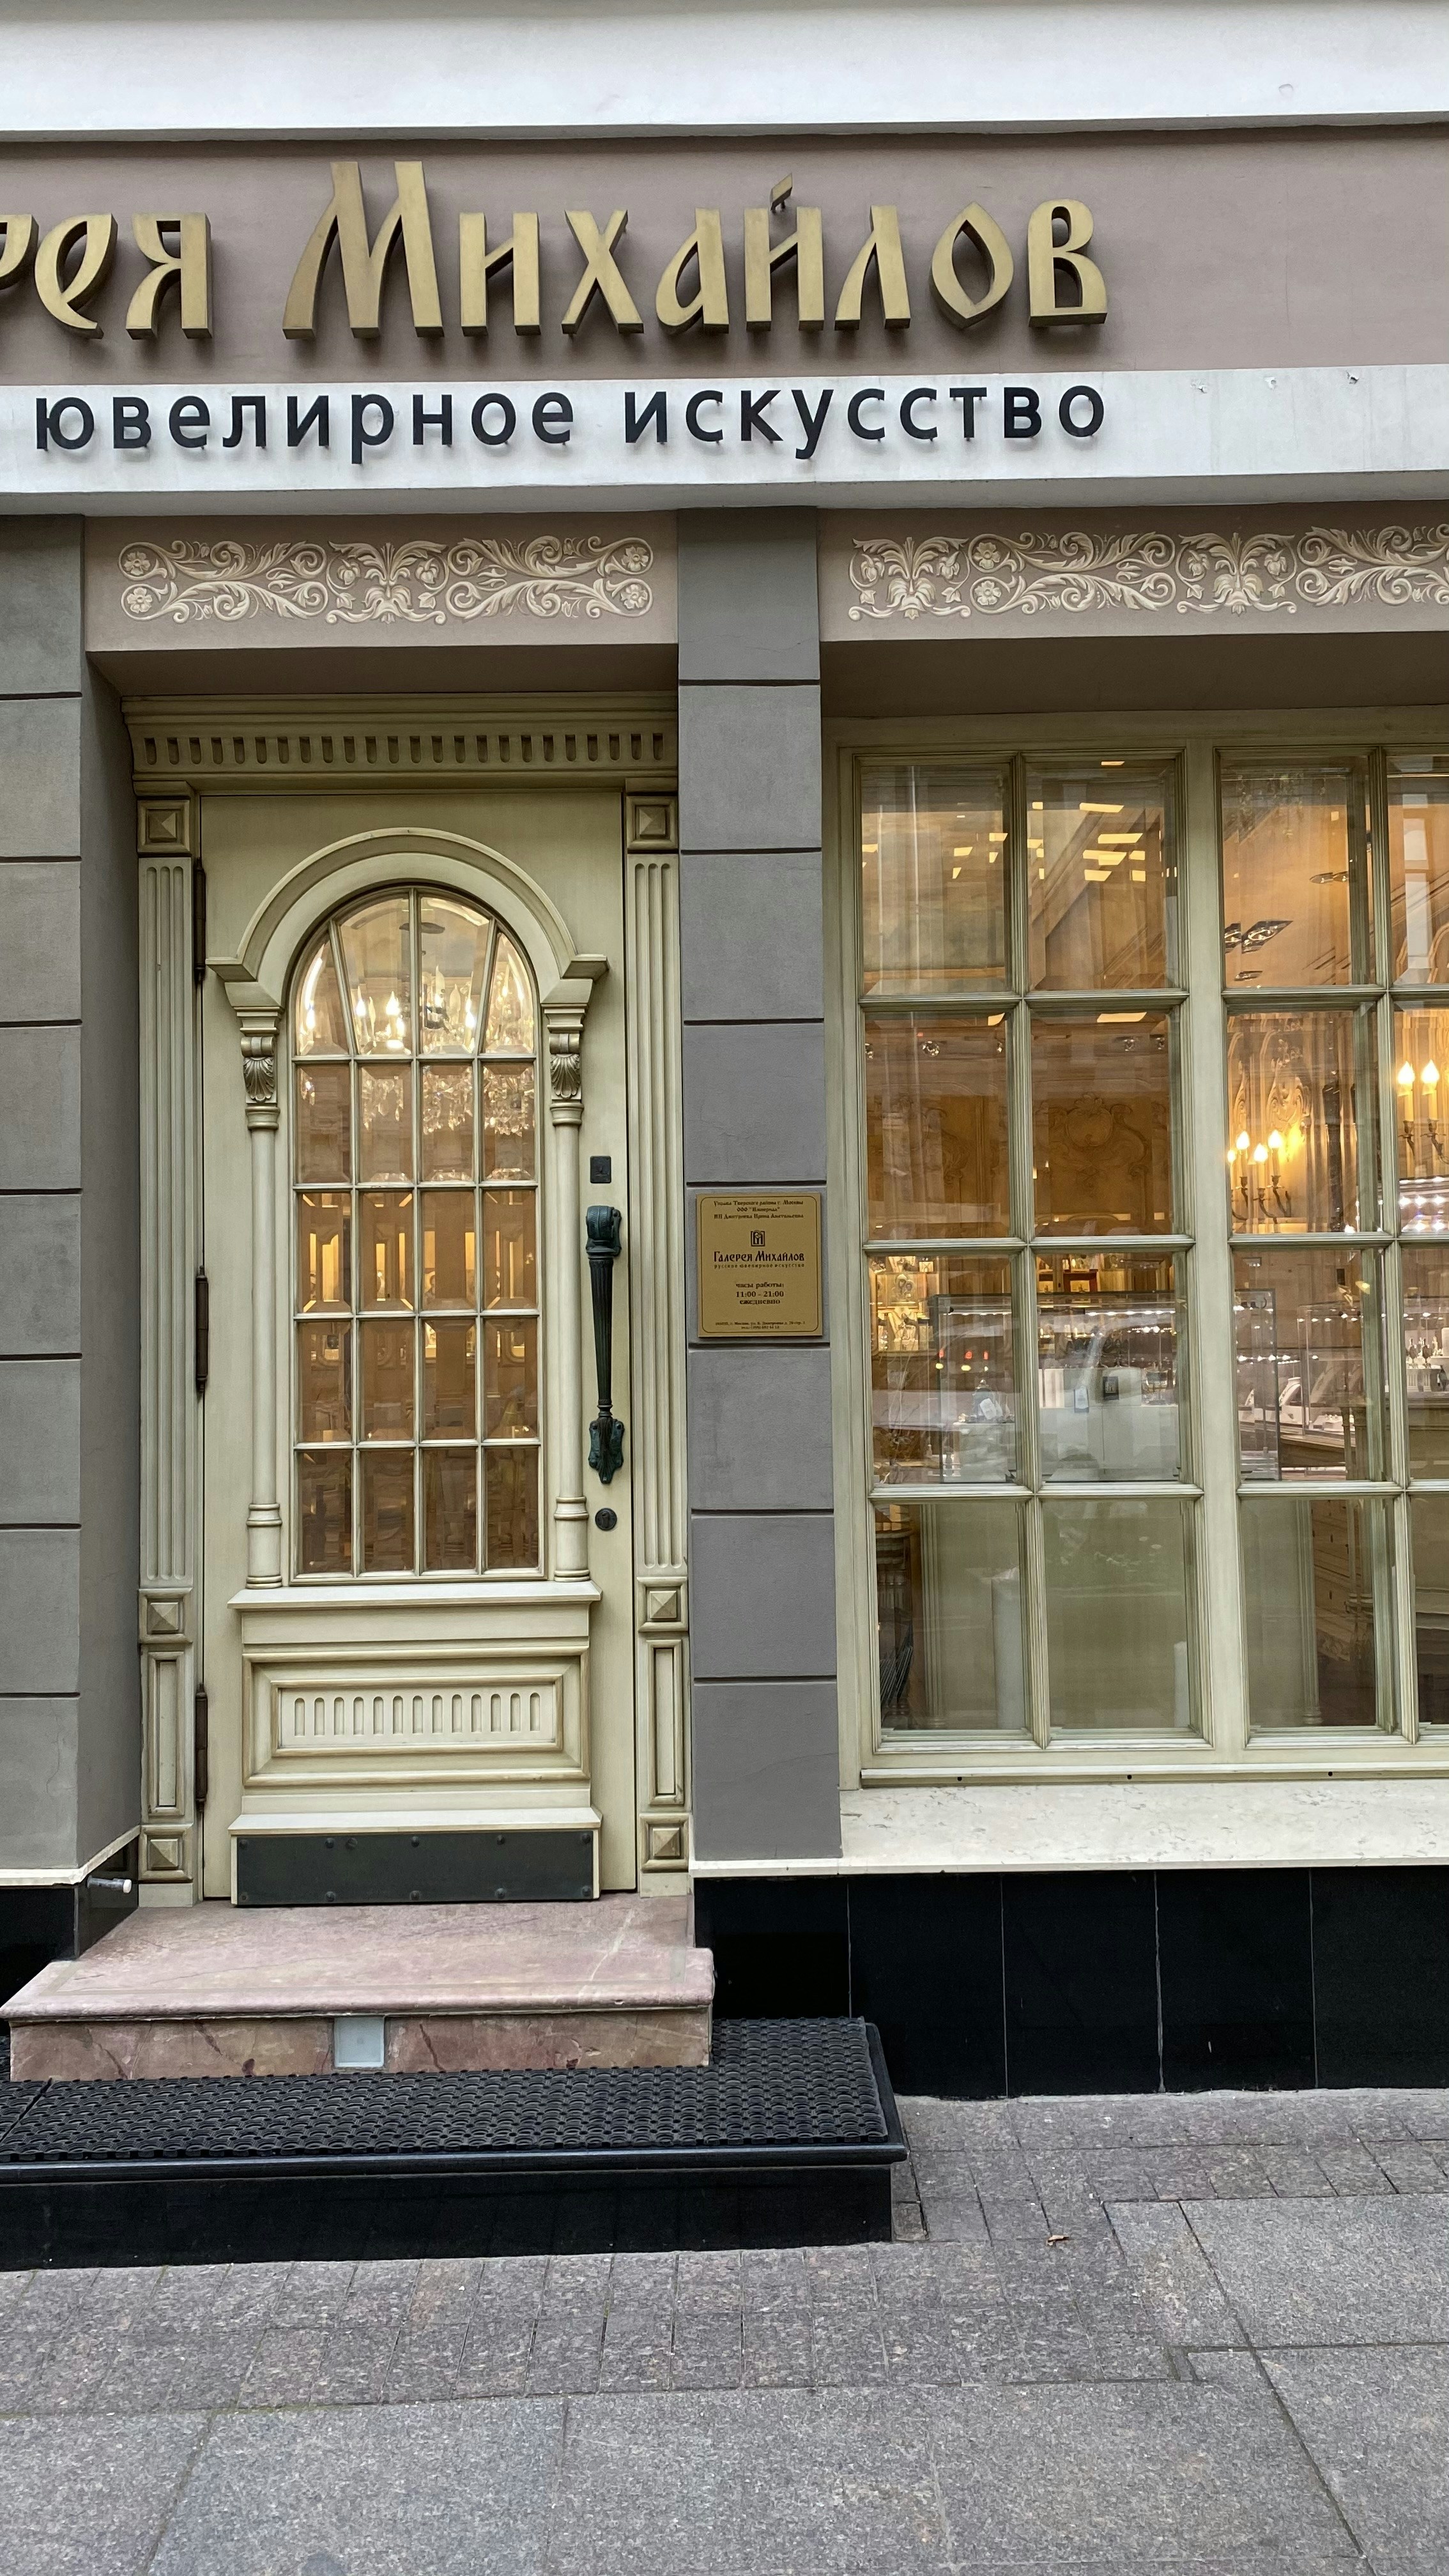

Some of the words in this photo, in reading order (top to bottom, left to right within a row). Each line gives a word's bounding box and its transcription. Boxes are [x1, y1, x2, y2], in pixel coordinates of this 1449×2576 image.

[282, 160, 1108, 340] Михайлов
[36, 390, 574, 464] ювелирное
[624, 385, 1105, 460] искусство
[714, 1251, 753, 1262] Галерея
[755, 1250, 804, 1261] Михайлов
